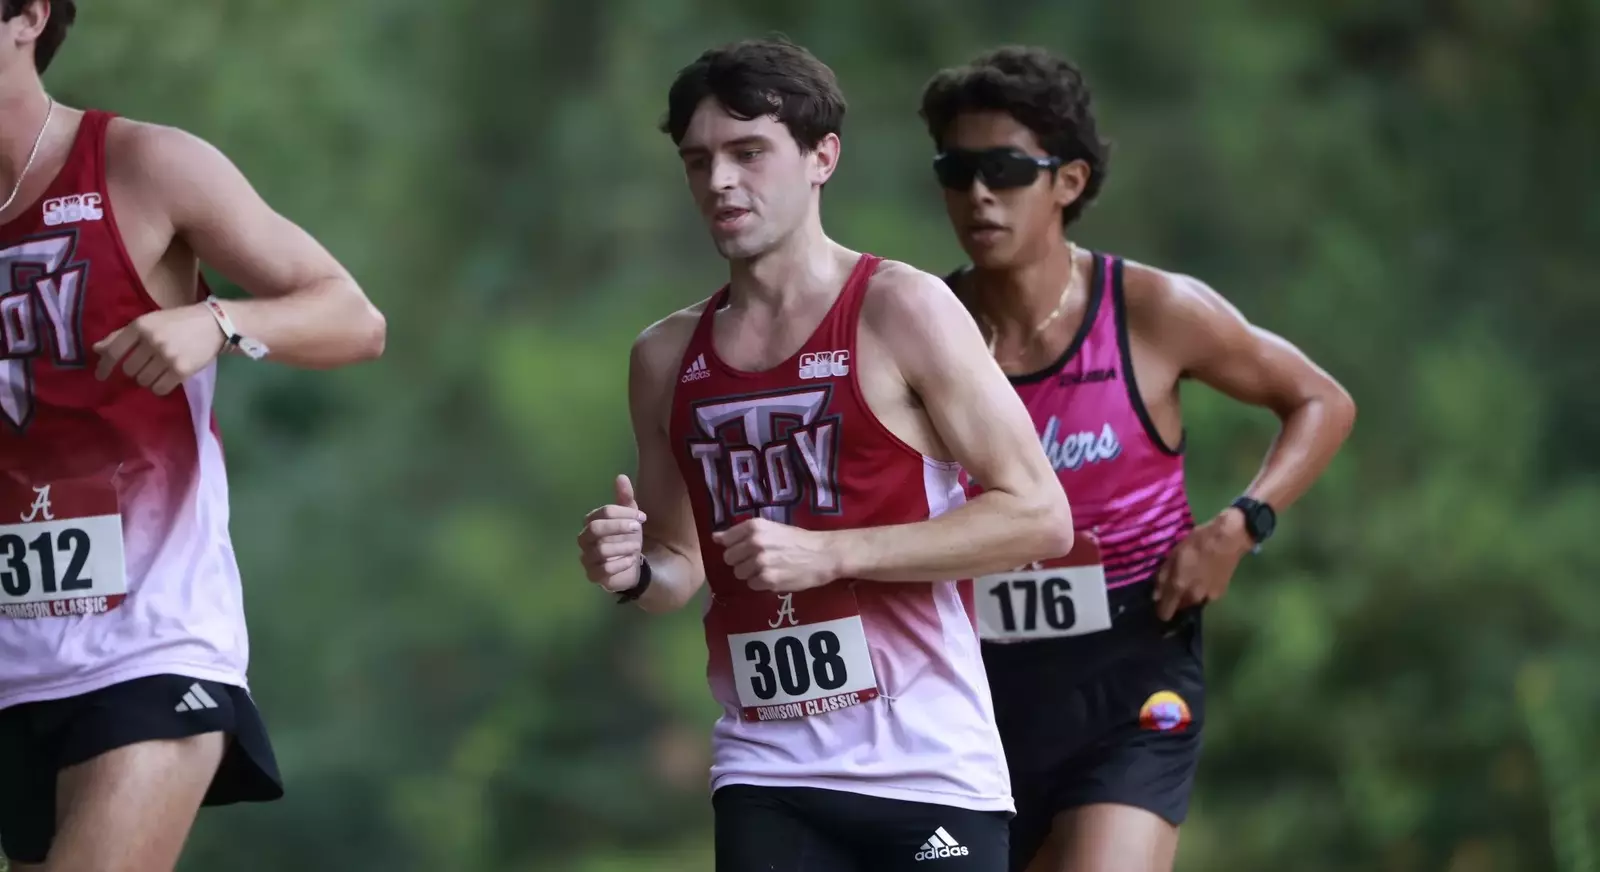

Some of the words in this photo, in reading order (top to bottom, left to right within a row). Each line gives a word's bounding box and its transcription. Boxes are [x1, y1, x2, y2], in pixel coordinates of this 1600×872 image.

[43, 192, 103, 226] SBC
[681, 367, 712, 384] adidas
[798, 350, 850, 380] SBC
[1040, 414, 1121, 471] hers
[687, 422, 838, 526] TROY
[20, 484, 54, 522] A
[0, 528, 93, 597] 312
[53, 596, 108, 616] CLASSIC
[768, 592, 799, 628] A
[988, 576, 1076, 632] 176
[744, 630, 848, 700] 308
[756, 700, 804, 721] CRIMSON
[805, 692, 861, 716] CLASSIC
[914, 845, 969, 862] adidas
